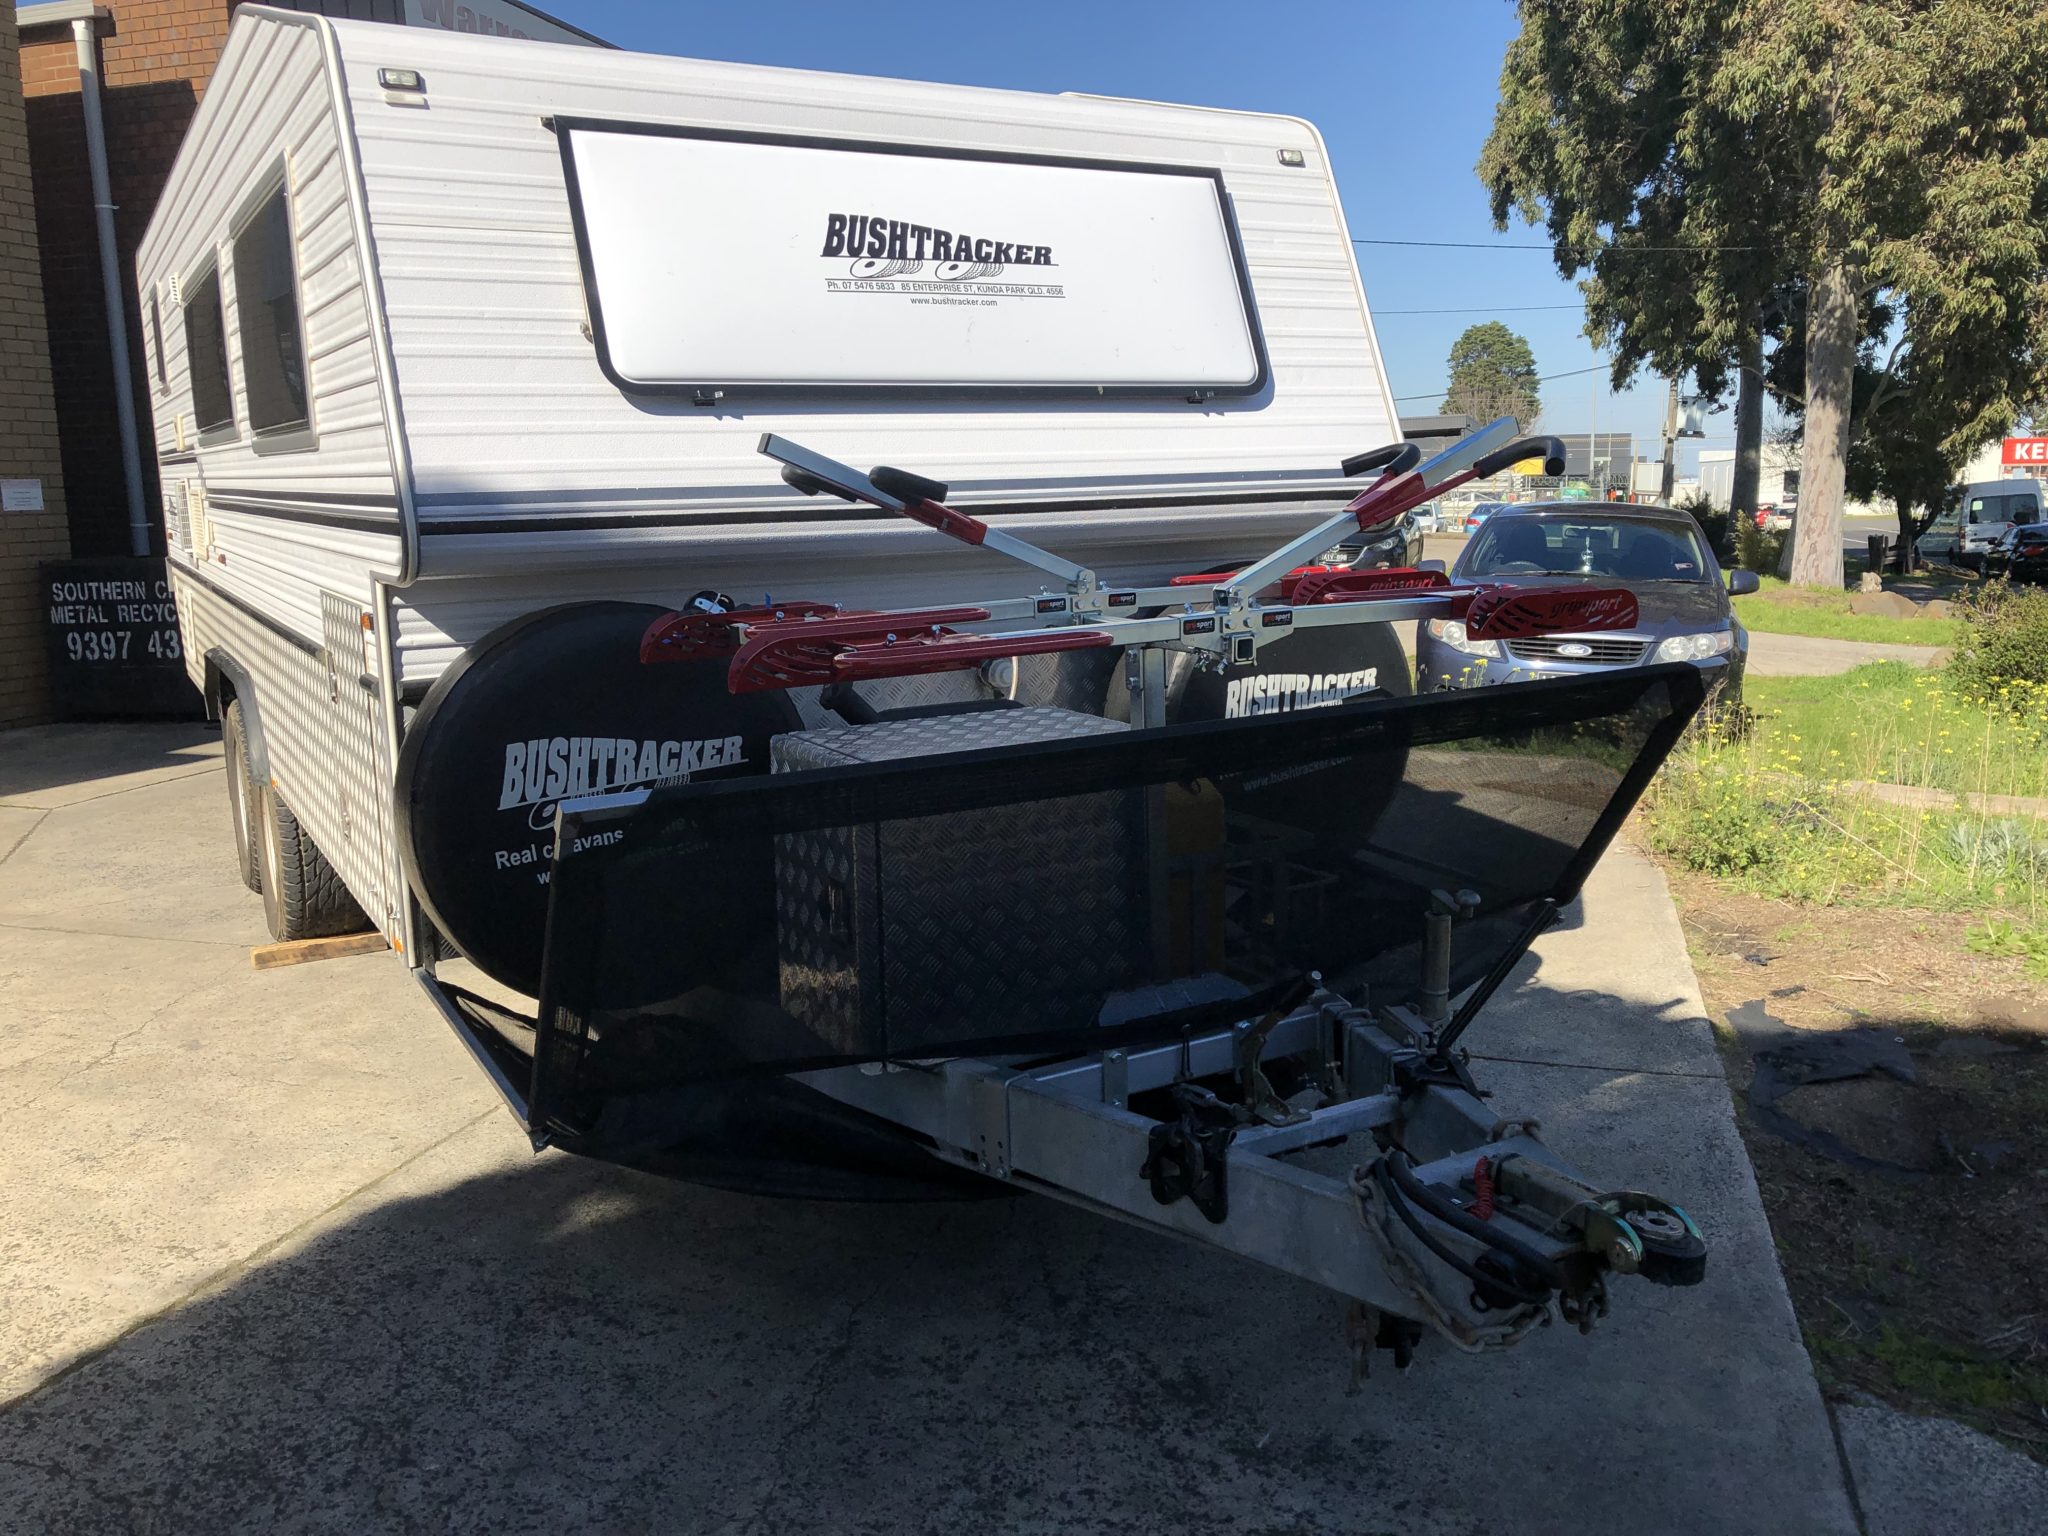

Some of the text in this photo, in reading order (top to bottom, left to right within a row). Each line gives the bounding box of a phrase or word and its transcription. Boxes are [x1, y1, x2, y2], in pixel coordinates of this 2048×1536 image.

[822, 213, 1053, 265] BUSHTRACKER
[827, 281, 840, 290] Ph.
[842, 281, 851, 290] 07
[854, 282, 874, 290] 5476
[875, 282, 895, 291] 5833
[901, 283, 911, 291] 85
[913, 283, 961, 292] ENTERPRISE
[963, 285, 976, 294] ST,
[977, 286, 1004, 294] KUNDA
[1005, 286, 1026, 295] PARK
[1046, 288, 1064, 296] 4556
[910, 297, 997, 307] www.bushtracker.com
[2015, 443, 2048, 460] KE
[52, 581, 146, 601] SOUTHERN
[50, 605, 109, 624] METAL
[67, 630, 180, 661] 9397 43
[1225, 667, 1378, 719] BUSHTRACKER
[500, 735, 744, 808] BUSHTRACKER
[495, 843, 538, 870] Real
[542, 829, 624, 859] cavans
